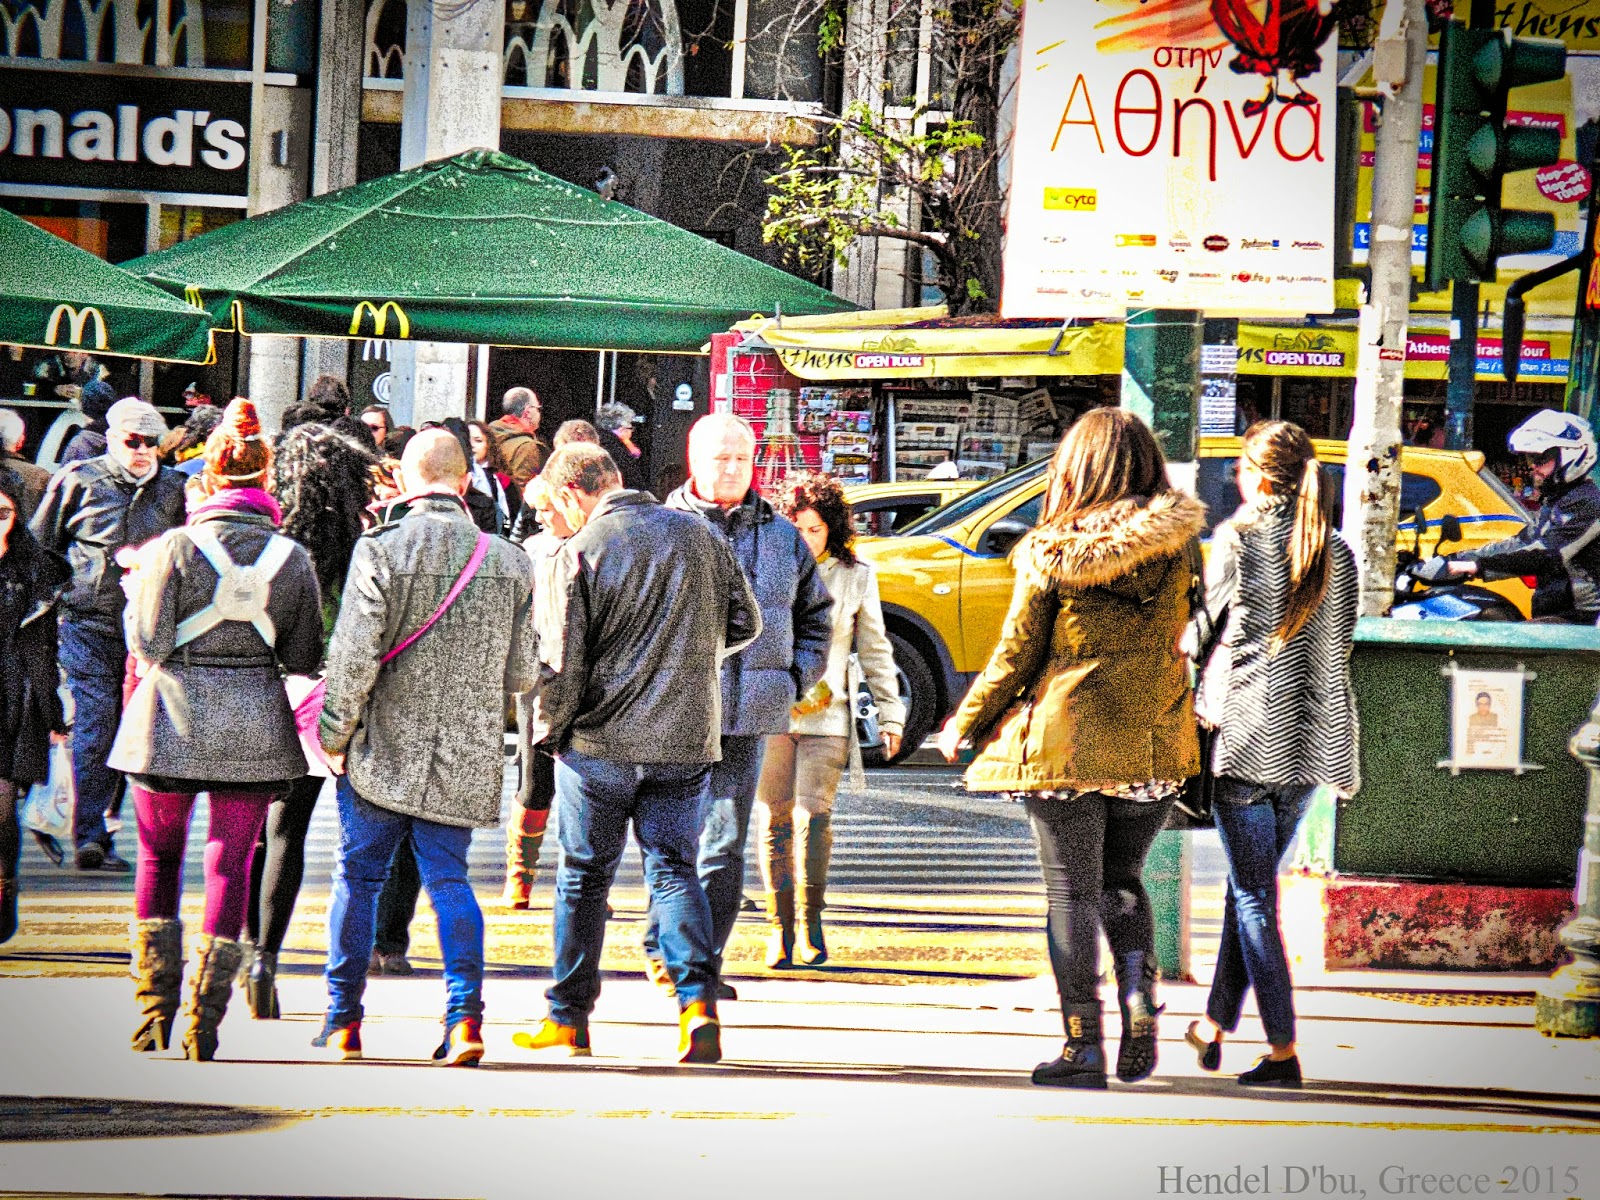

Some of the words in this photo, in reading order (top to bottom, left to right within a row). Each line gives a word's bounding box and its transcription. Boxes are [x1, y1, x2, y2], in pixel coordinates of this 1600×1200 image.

[1494, 2, 1600, 39] thens
[1153, 46, 1223, 77] στην
[1051, 69, 1325, 182] Αθήνα
[0, 104, 246, 170] nald's
[1065, 194, 1096, 208] cyta
[1268, 353, 1304, 364] OPEN
[1306, 353, 1342, 365] TOUR
[1409, 343, 1450, 354] Athens
[1477, 344, 1503, 356] irae
[857, 355, 889, 367] OPEN
